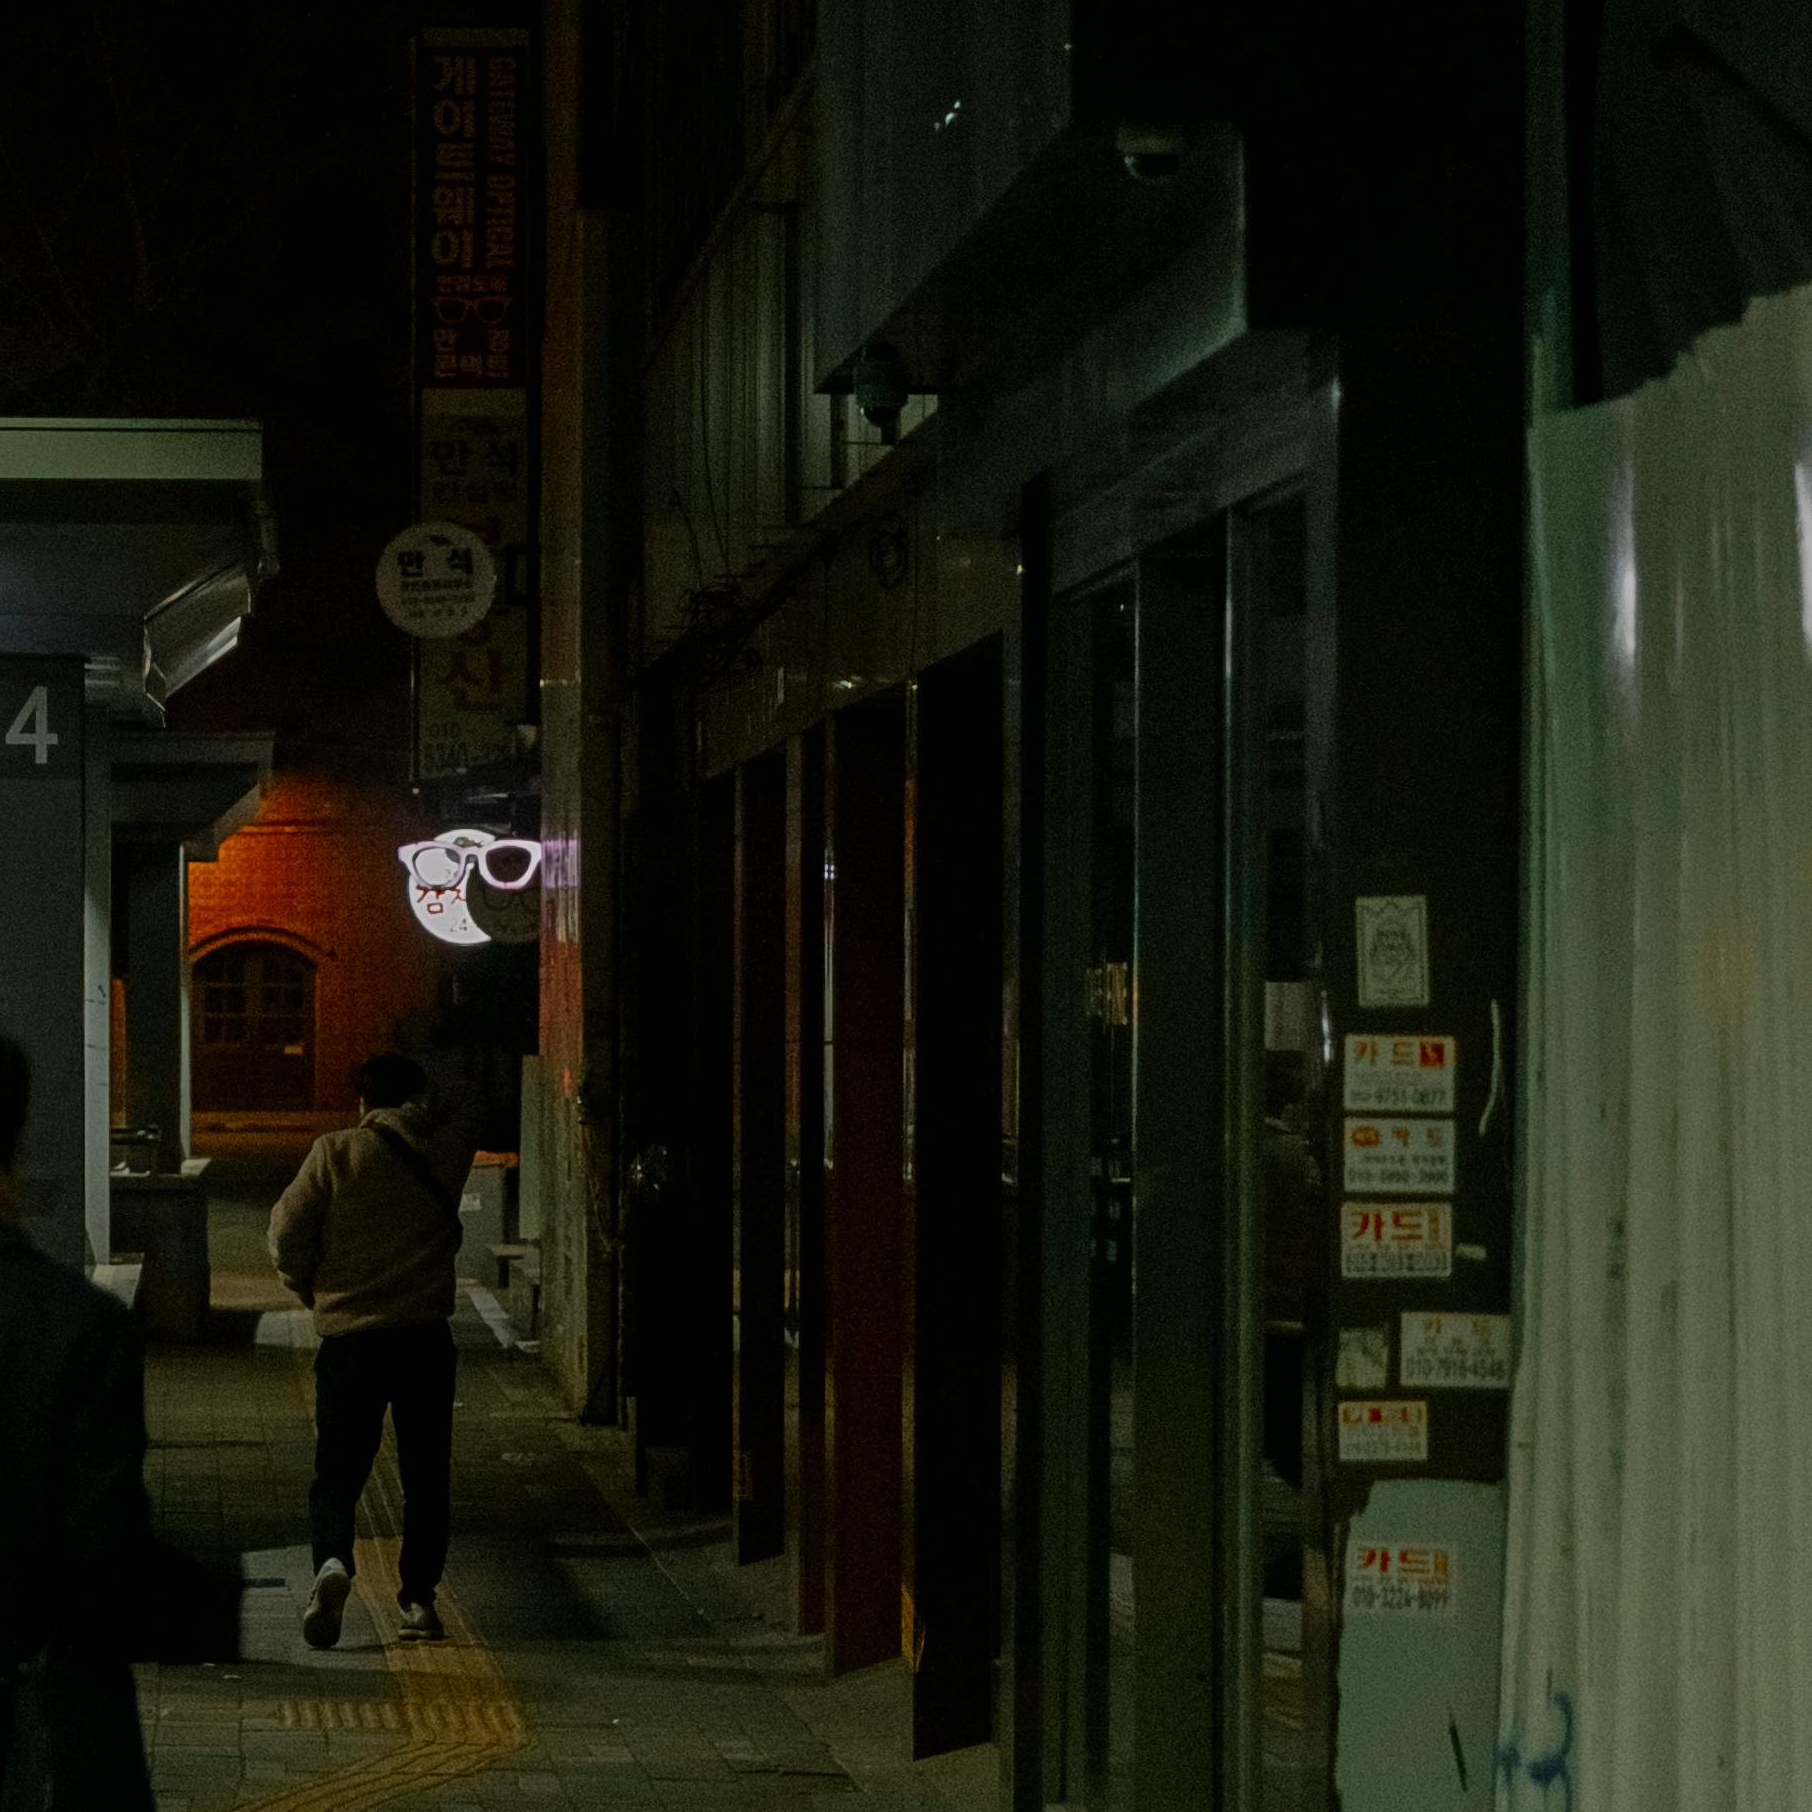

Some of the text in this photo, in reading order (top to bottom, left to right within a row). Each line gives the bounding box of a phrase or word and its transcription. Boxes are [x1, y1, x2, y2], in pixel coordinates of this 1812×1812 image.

[431, 55, 479, 269] 게이트웨이
[485, 55, 517, 269] GATEWAY OPTICAL
[5, 684, 59, 765] 4
